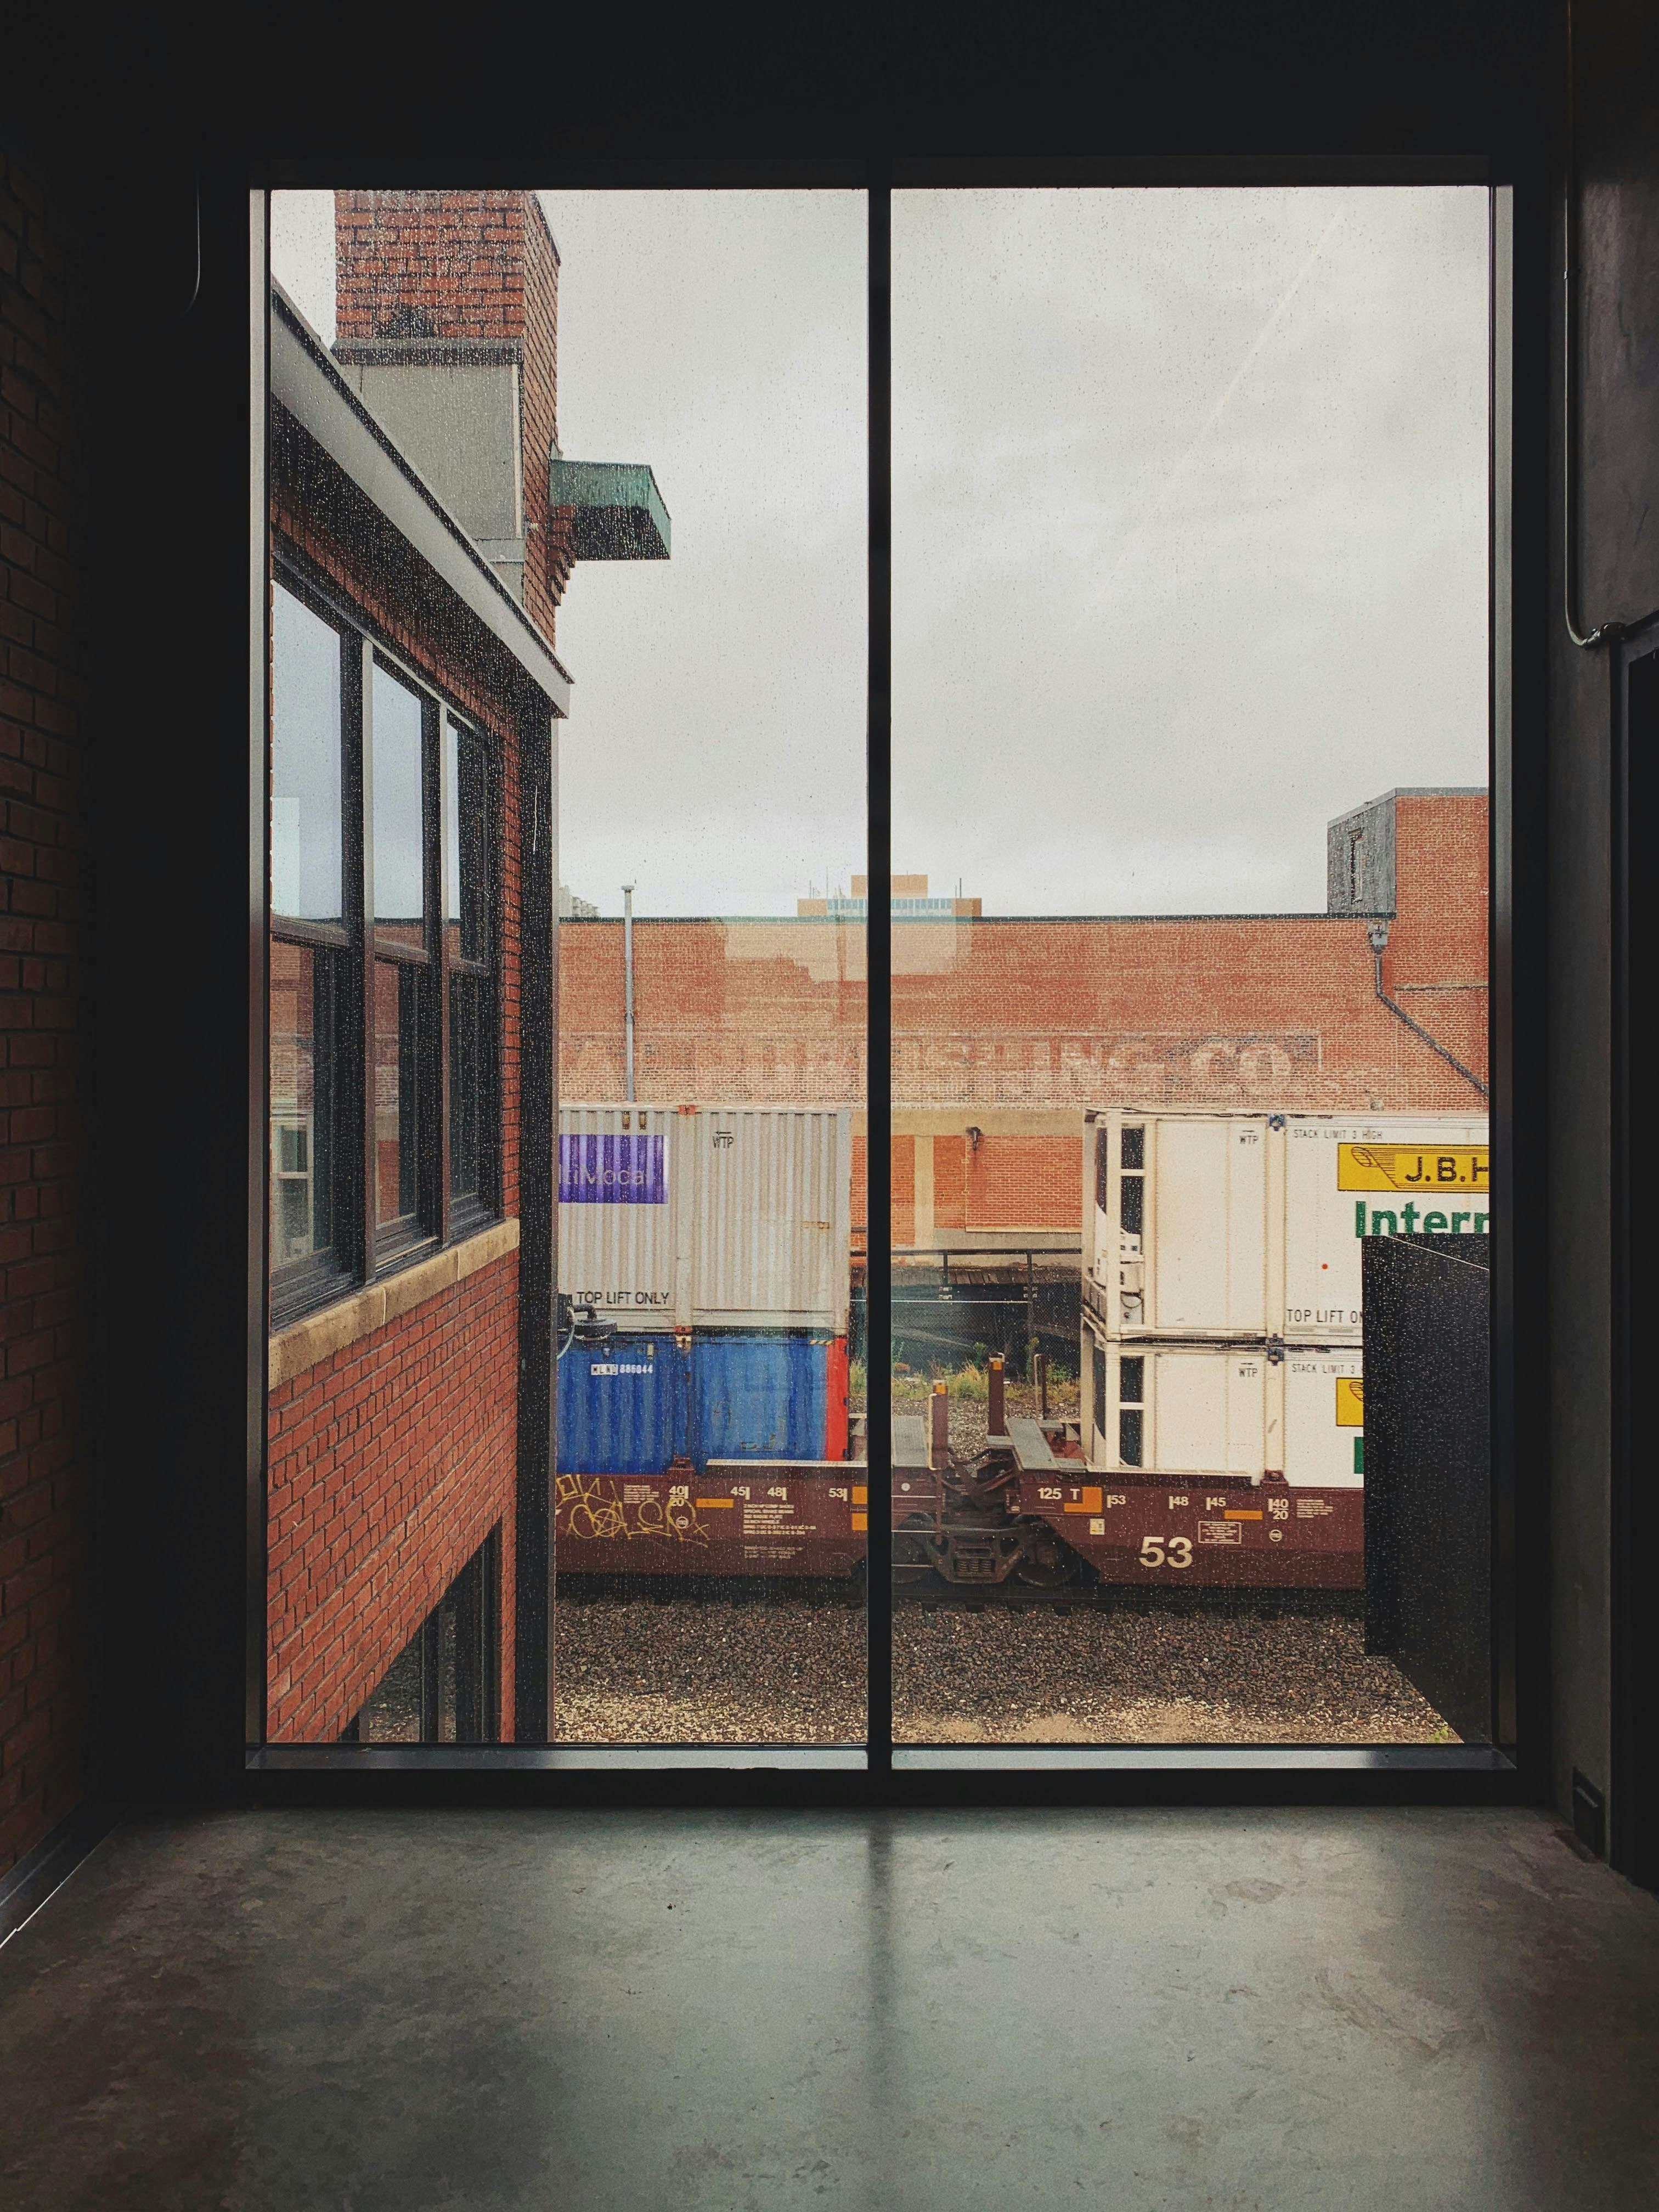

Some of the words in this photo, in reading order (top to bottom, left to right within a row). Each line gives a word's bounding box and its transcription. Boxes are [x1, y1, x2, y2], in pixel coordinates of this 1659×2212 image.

[1294, 1129, 1318, 1138] STACK
[1324, 1130, 1347, 1139] LIMIT
[712, 1136, 734, 1148] WTP
[1239, 1135, 1259, 1144] WTP
[577, 1291, 602, 1304] TOP
[606, 1291, 631, 1304] LIFT
[635, 1291, 669, 1305] ONLY
[1287, 1309, 1312, 1322] TOP
[1317, 1310, 1344, 1323] LIFT
[1238, 1368, 1259, 1378] WTP
[1292, 1364, 1317, 1373] STACK
[1323, 1364, 1345, 1374] LIMIT
[669, 1486, 685, 1495] 40
[730, 1487, 746, 1496] 45
[767, 1487, 783, 1497] 48
[828, 1488, 844, 1498] 53
[1037, 1487, 1062, 1500] 125
[1070, 1488, 1080, 1500] T
[670, 1497, 685, 1506] 20
[1111, 1494, 1126, 1505] 53
[1173, 1496, 1189, 1506] 48
[1210, 1497, 1226, 1507] 45
[1273, 1499, 1289, 1508] 40
[1273, 1510, 1289, 1520] 20
[1139, 1536, 1193, 1568] 53
